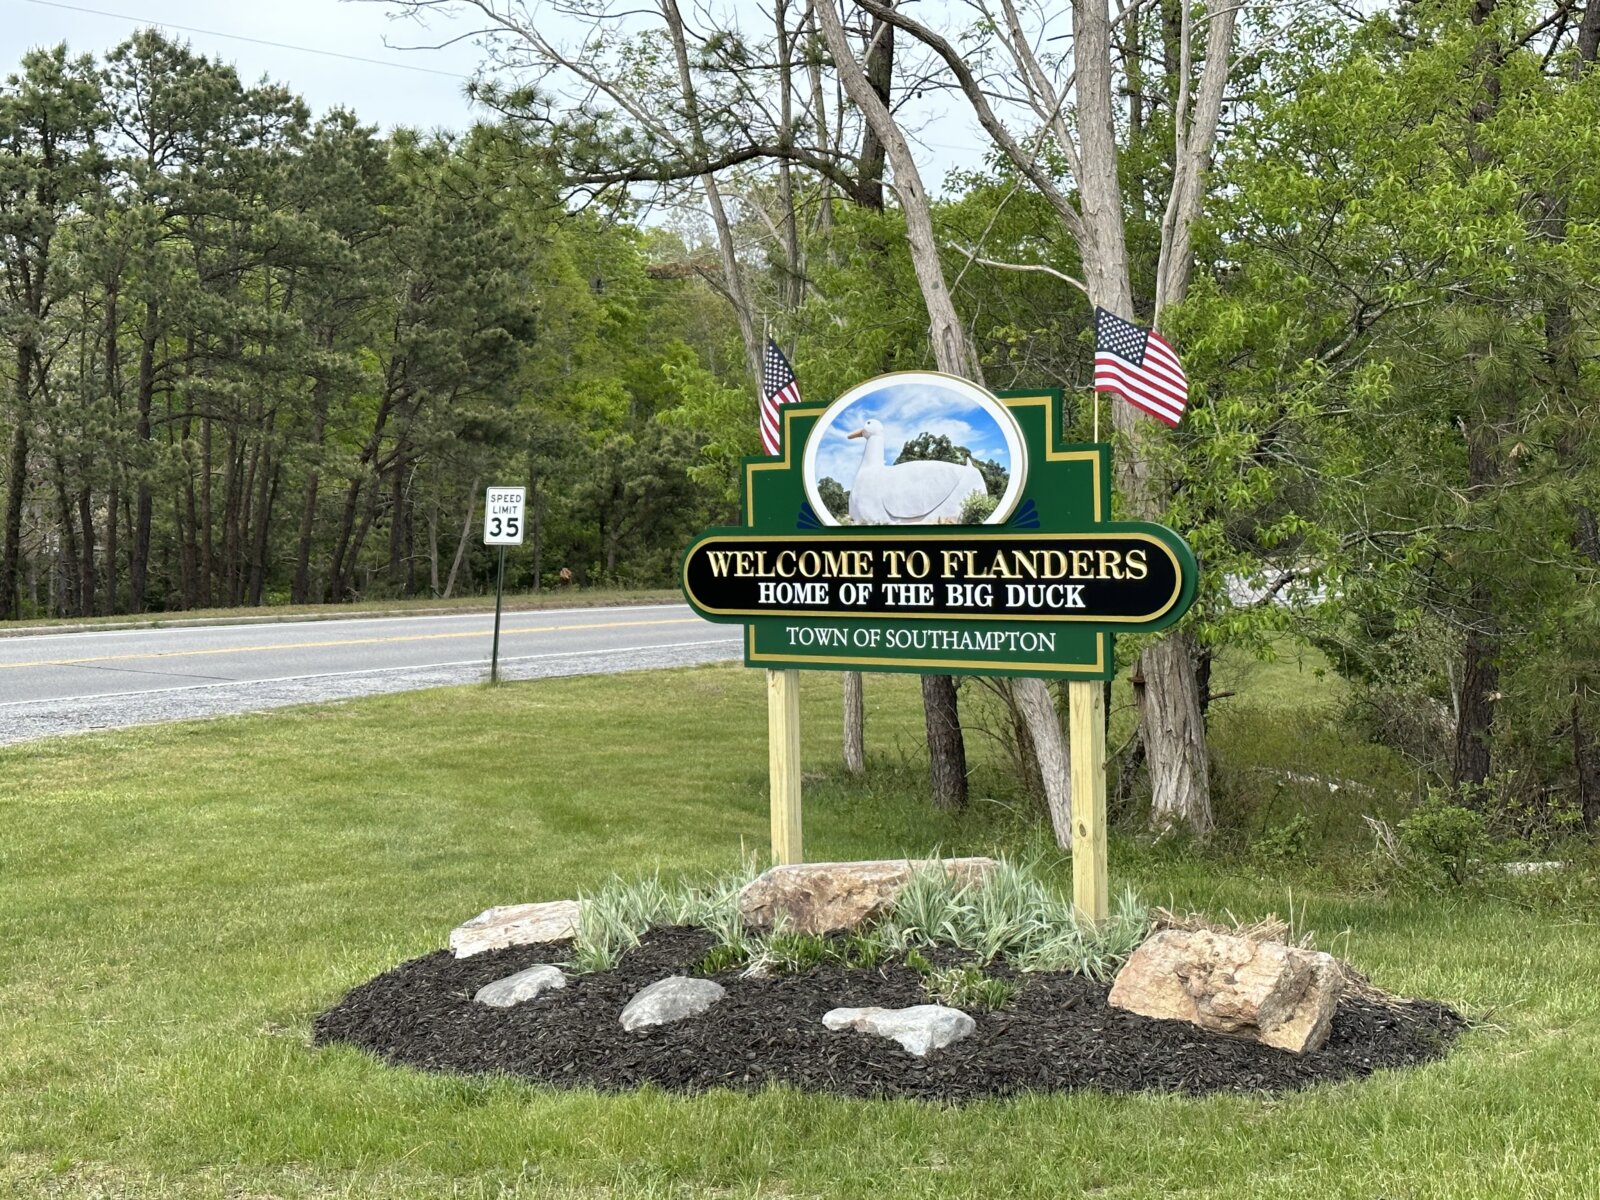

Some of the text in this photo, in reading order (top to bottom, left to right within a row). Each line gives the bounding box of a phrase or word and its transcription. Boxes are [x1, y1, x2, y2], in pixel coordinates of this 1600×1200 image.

[490, 494, 522, 503] SPEED
[492, 505, 518, 514] LIMIT
[489, 517, 519, 537] 35
[706, 549, 1148, 580] WELCOME TO FLANDERS
[758, 582, 1086, 608] HOME OF THE BIG DUCK
[786, 626, 1056, 652] TOWN OF SOUTHAMPTON
